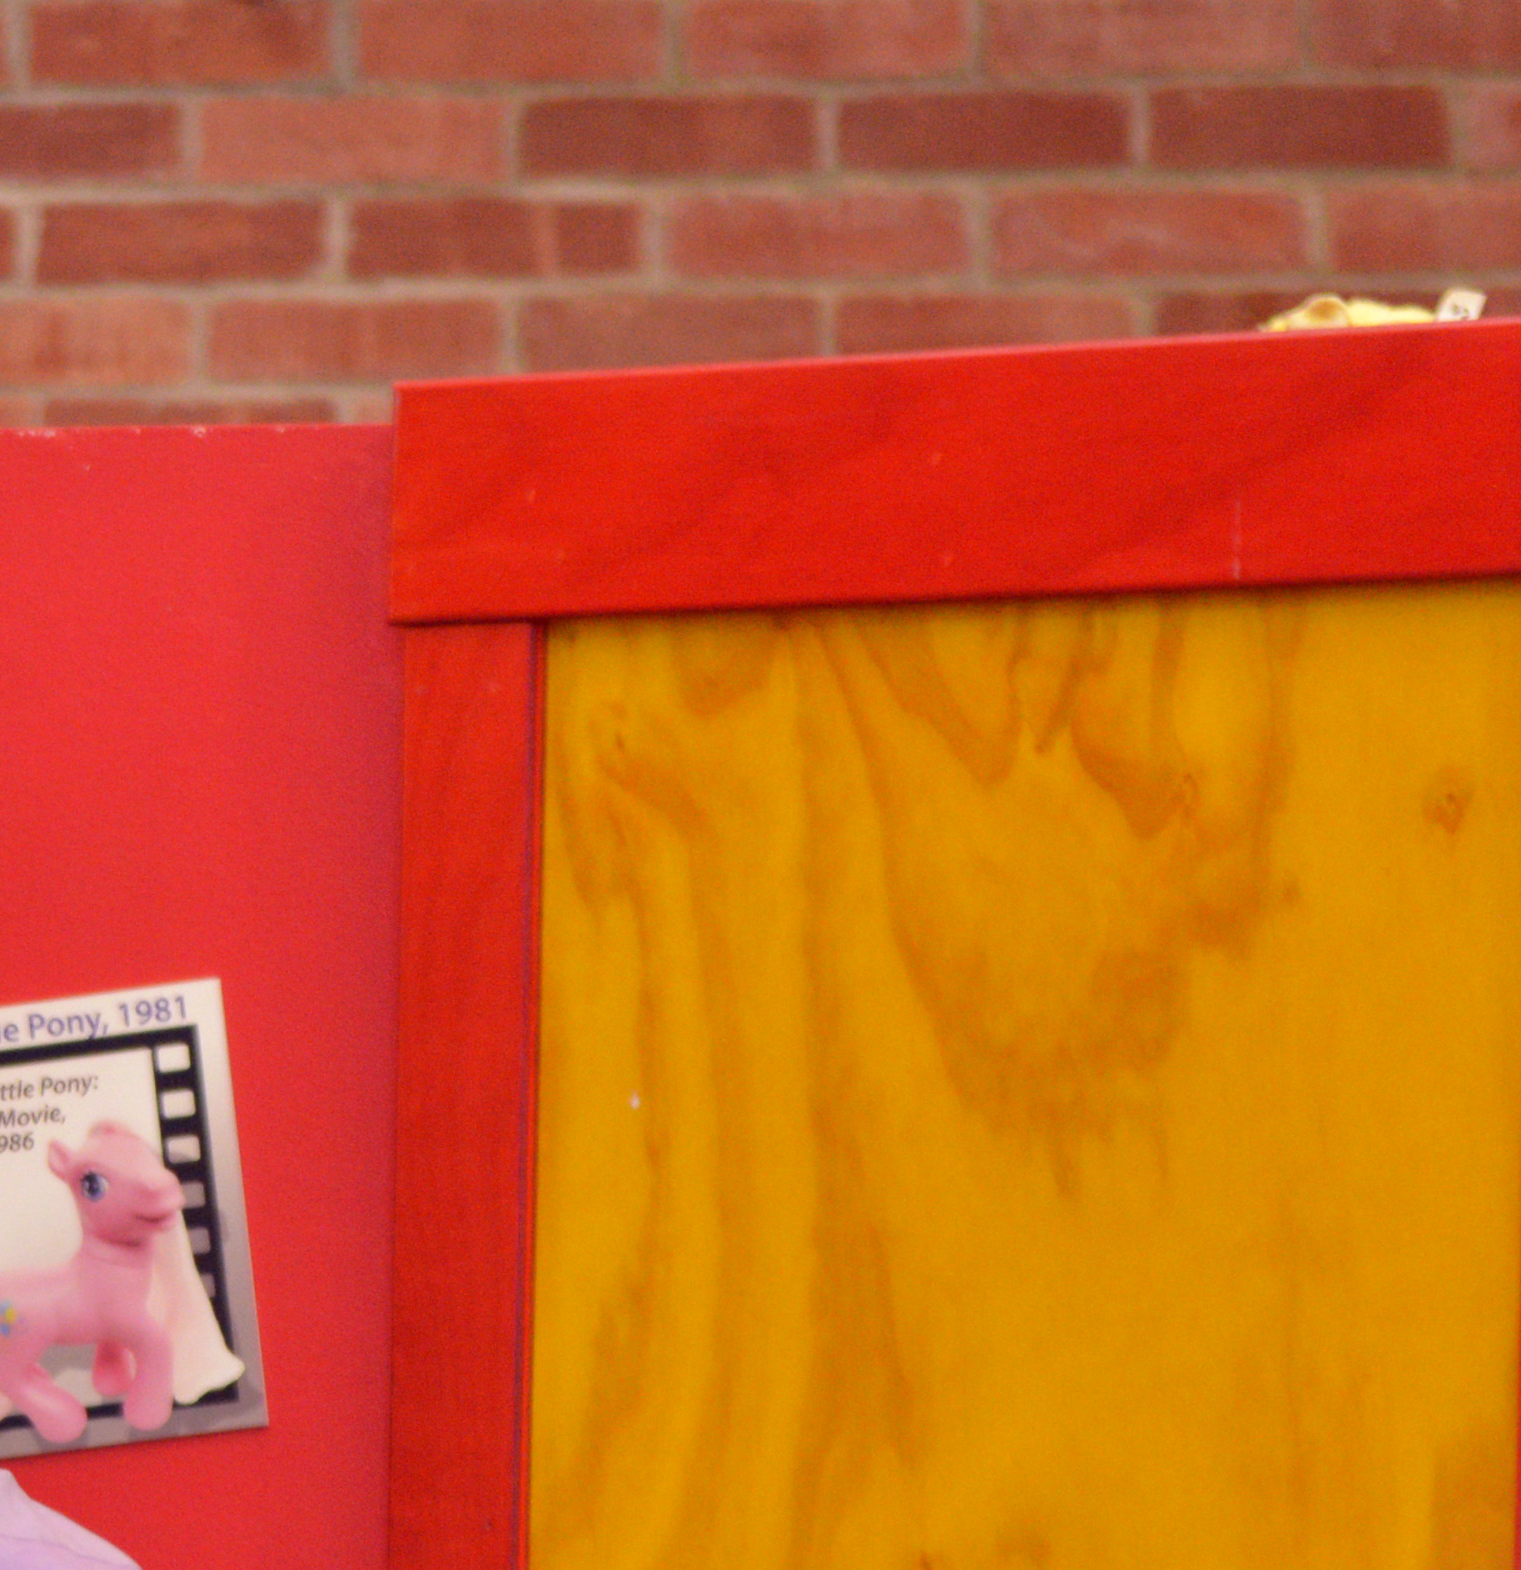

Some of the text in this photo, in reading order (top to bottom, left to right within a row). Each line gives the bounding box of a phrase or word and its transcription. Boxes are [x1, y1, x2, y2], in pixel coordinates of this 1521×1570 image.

[28, 1008, 109, 1040] Pony,
[120, 996, 188, 1027] 1981
[41, 1074, 99, 1097] Pony:
